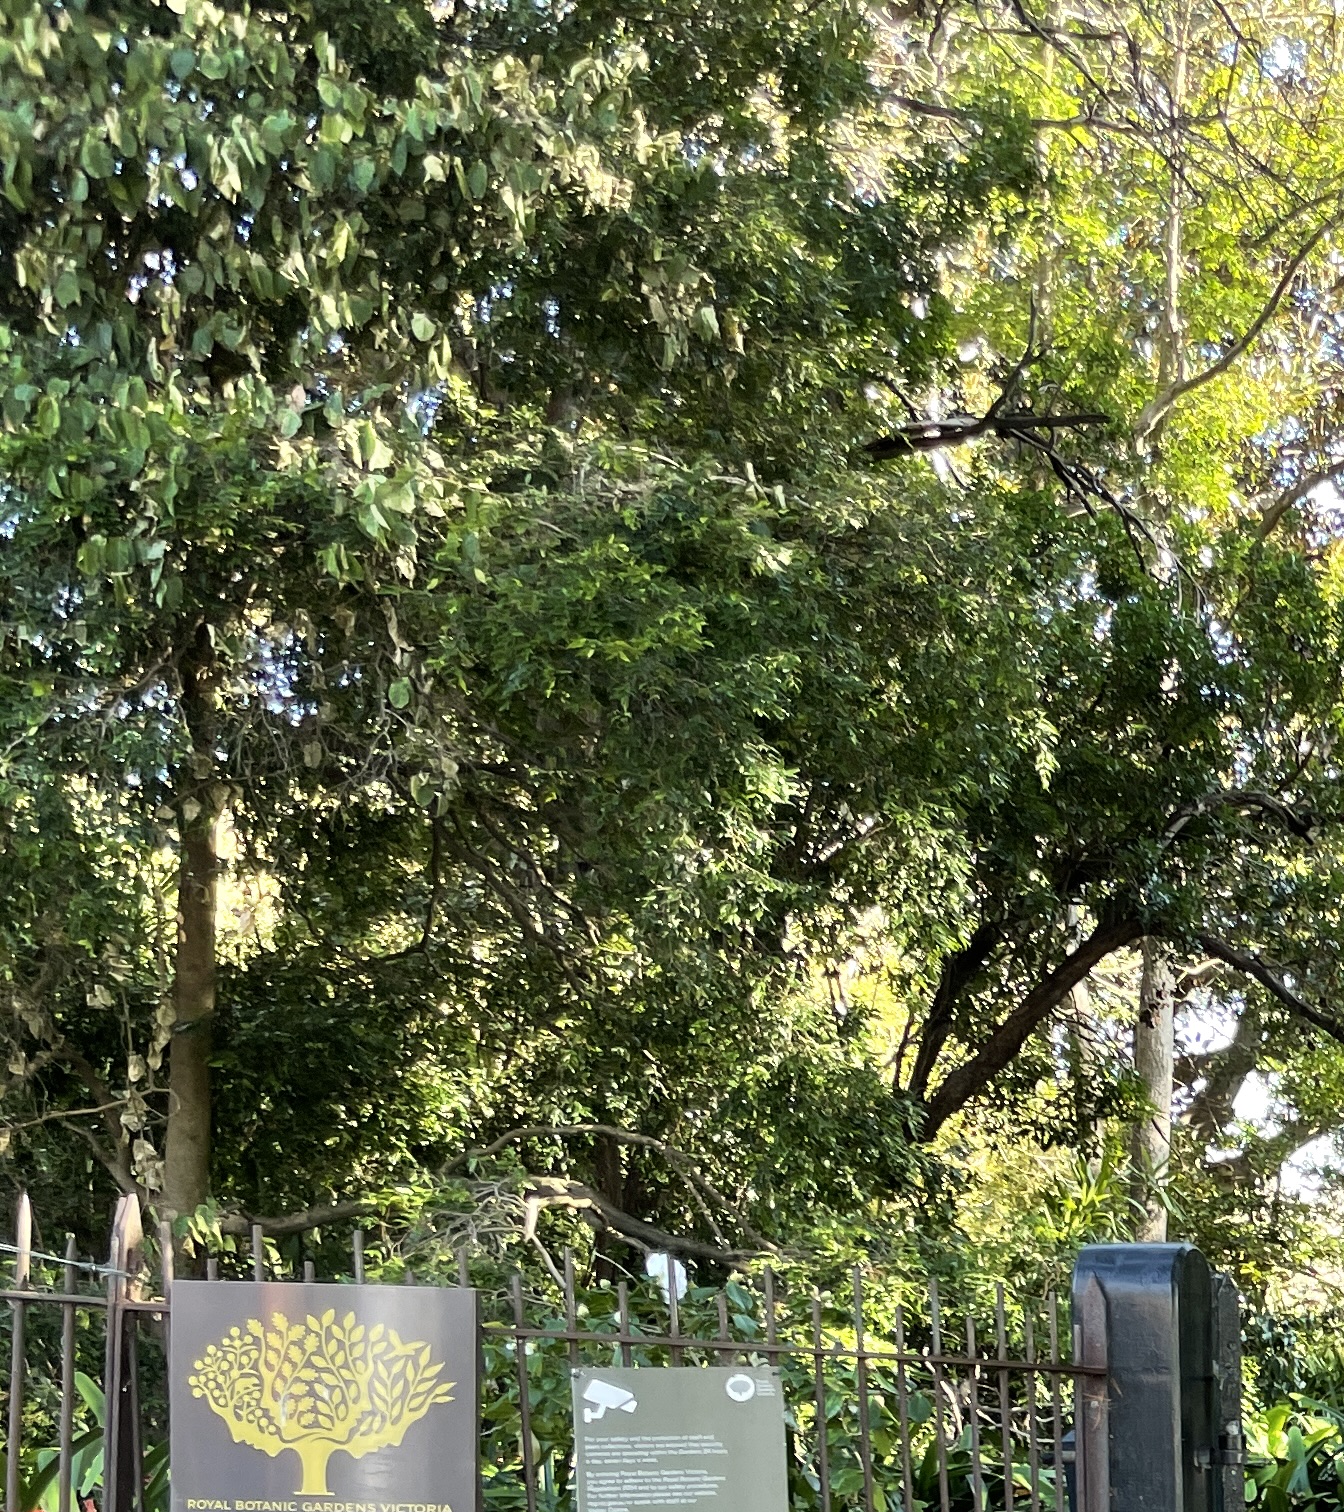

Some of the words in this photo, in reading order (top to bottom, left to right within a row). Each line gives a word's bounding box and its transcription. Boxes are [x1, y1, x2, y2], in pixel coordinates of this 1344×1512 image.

[187, 1499, 231, 1510] ROYAL
[236, 1500, 297, 1512] BOTANIC
[302, 1502, 376, 1512] GARDENS
